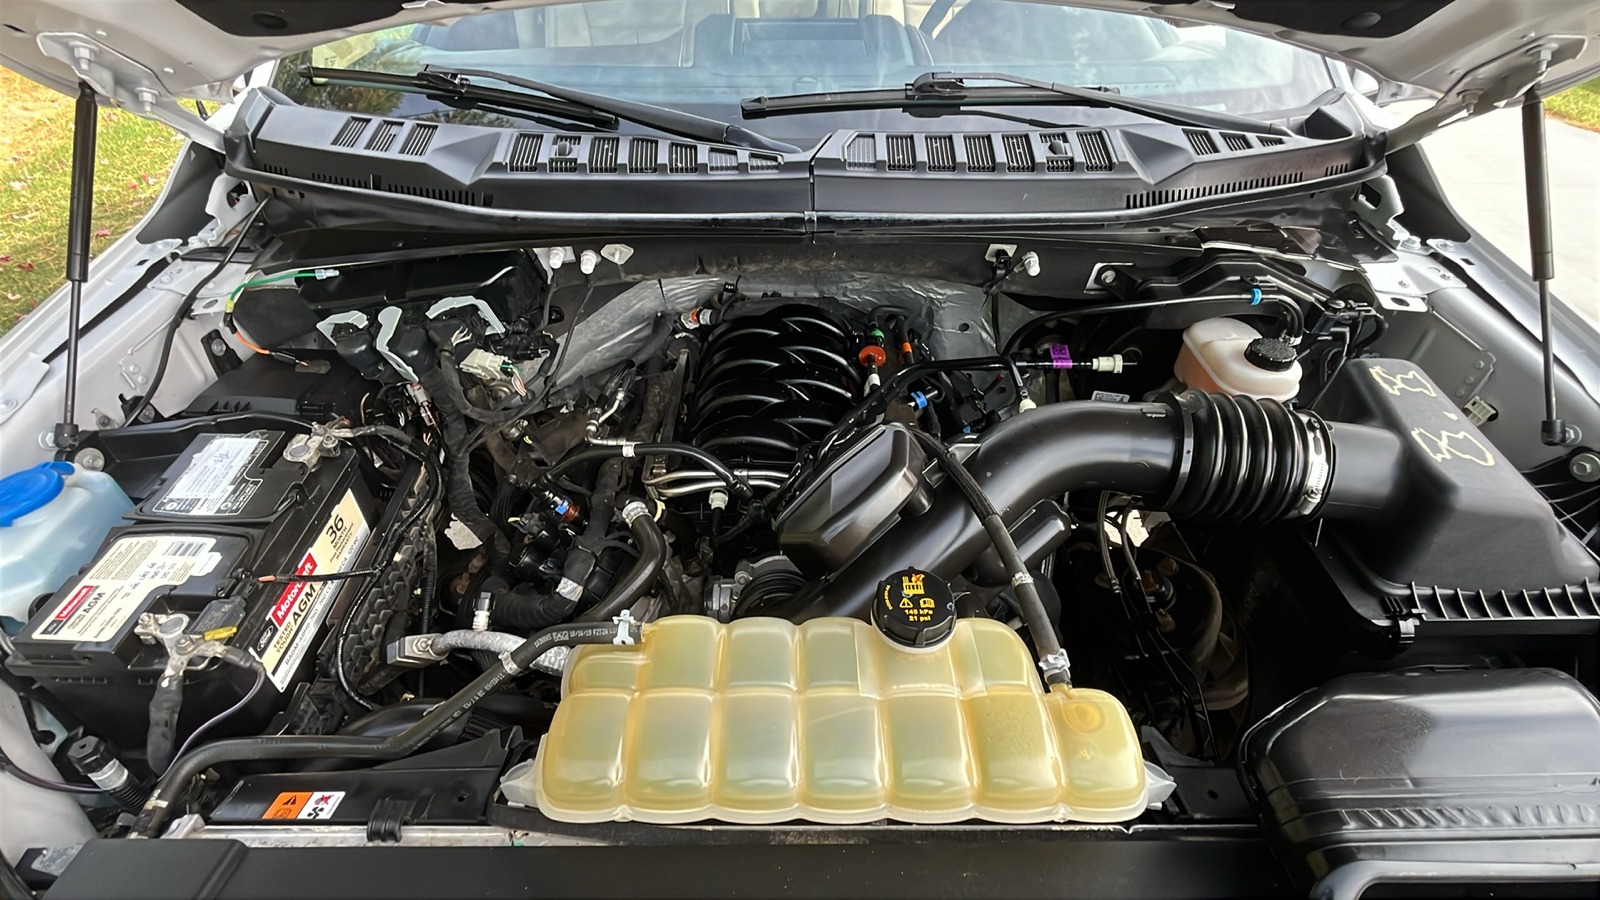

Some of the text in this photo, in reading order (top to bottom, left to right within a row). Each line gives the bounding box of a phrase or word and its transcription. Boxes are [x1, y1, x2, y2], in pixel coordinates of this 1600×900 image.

[322, 513, 345, 544] 36
[332, 525, 347, 550] MONTH
[82, 592, 106, 614] AGM
[275, 560, 313, 620] Motorcft
[275, 627, 293, 653] TOUGH
[289, 582, 317, 626] AGM
[272, 620, 291, 649] TESTED
